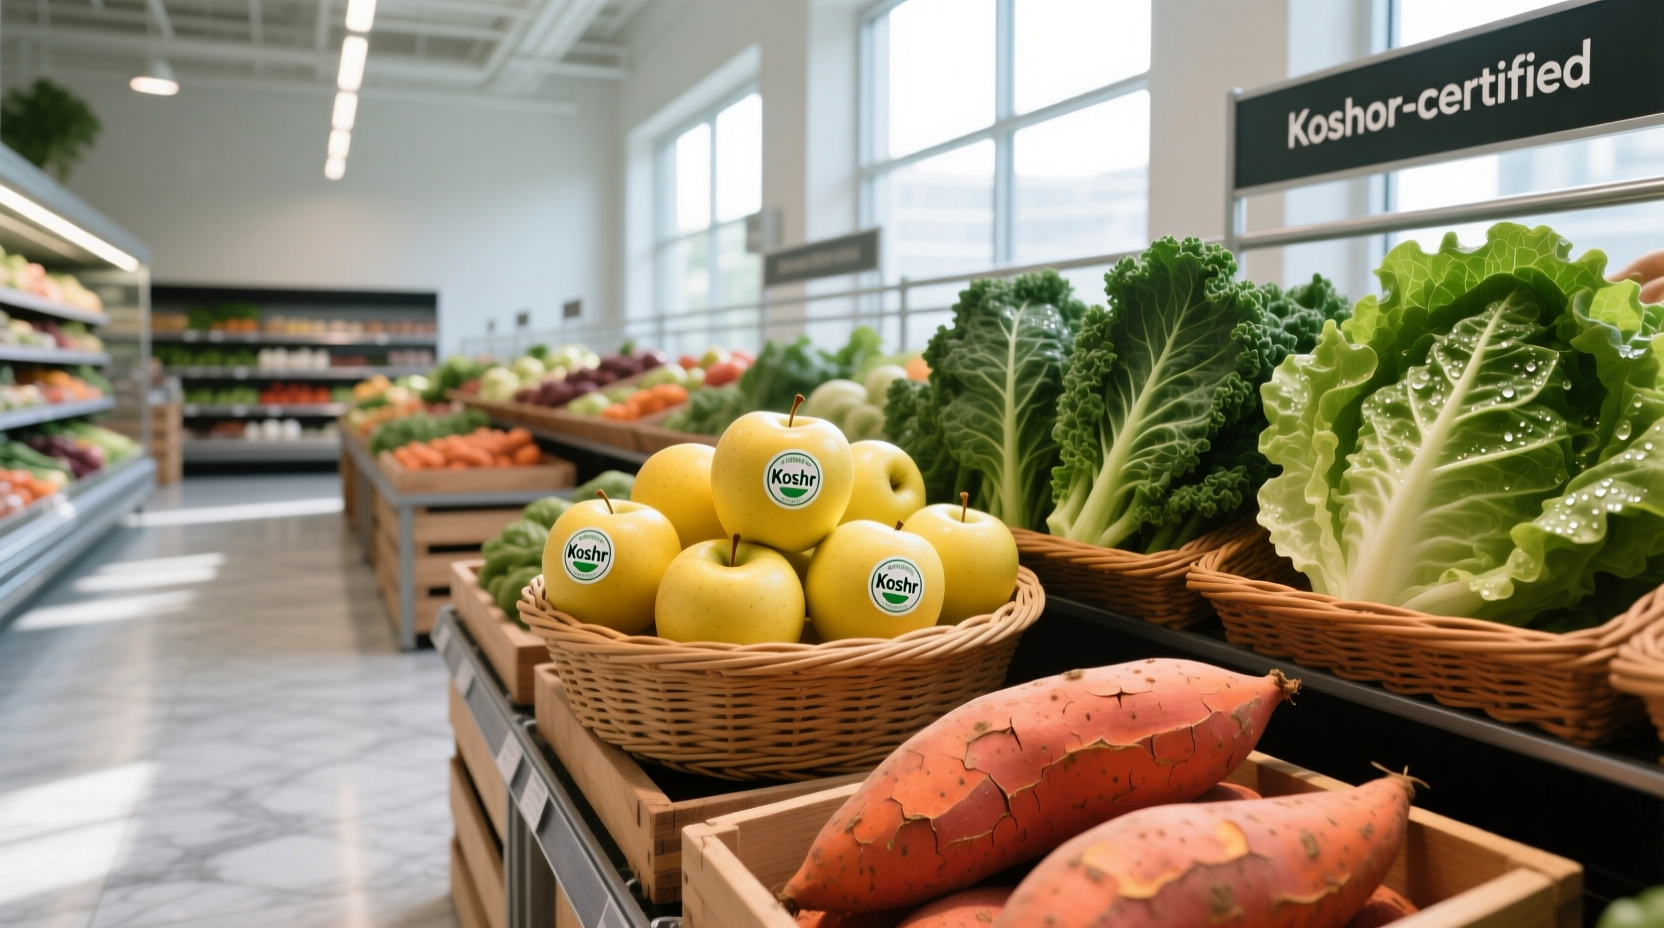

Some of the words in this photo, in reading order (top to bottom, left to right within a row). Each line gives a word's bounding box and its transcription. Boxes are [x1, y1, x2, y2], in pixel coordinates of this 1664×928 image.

[1287, 38, 1592, 150] Koshor-certified
[772, 468, 816, 487] Koshr
[568, 543, 608, 562] Koshr
[876, 573, 918, 594] Koshr
